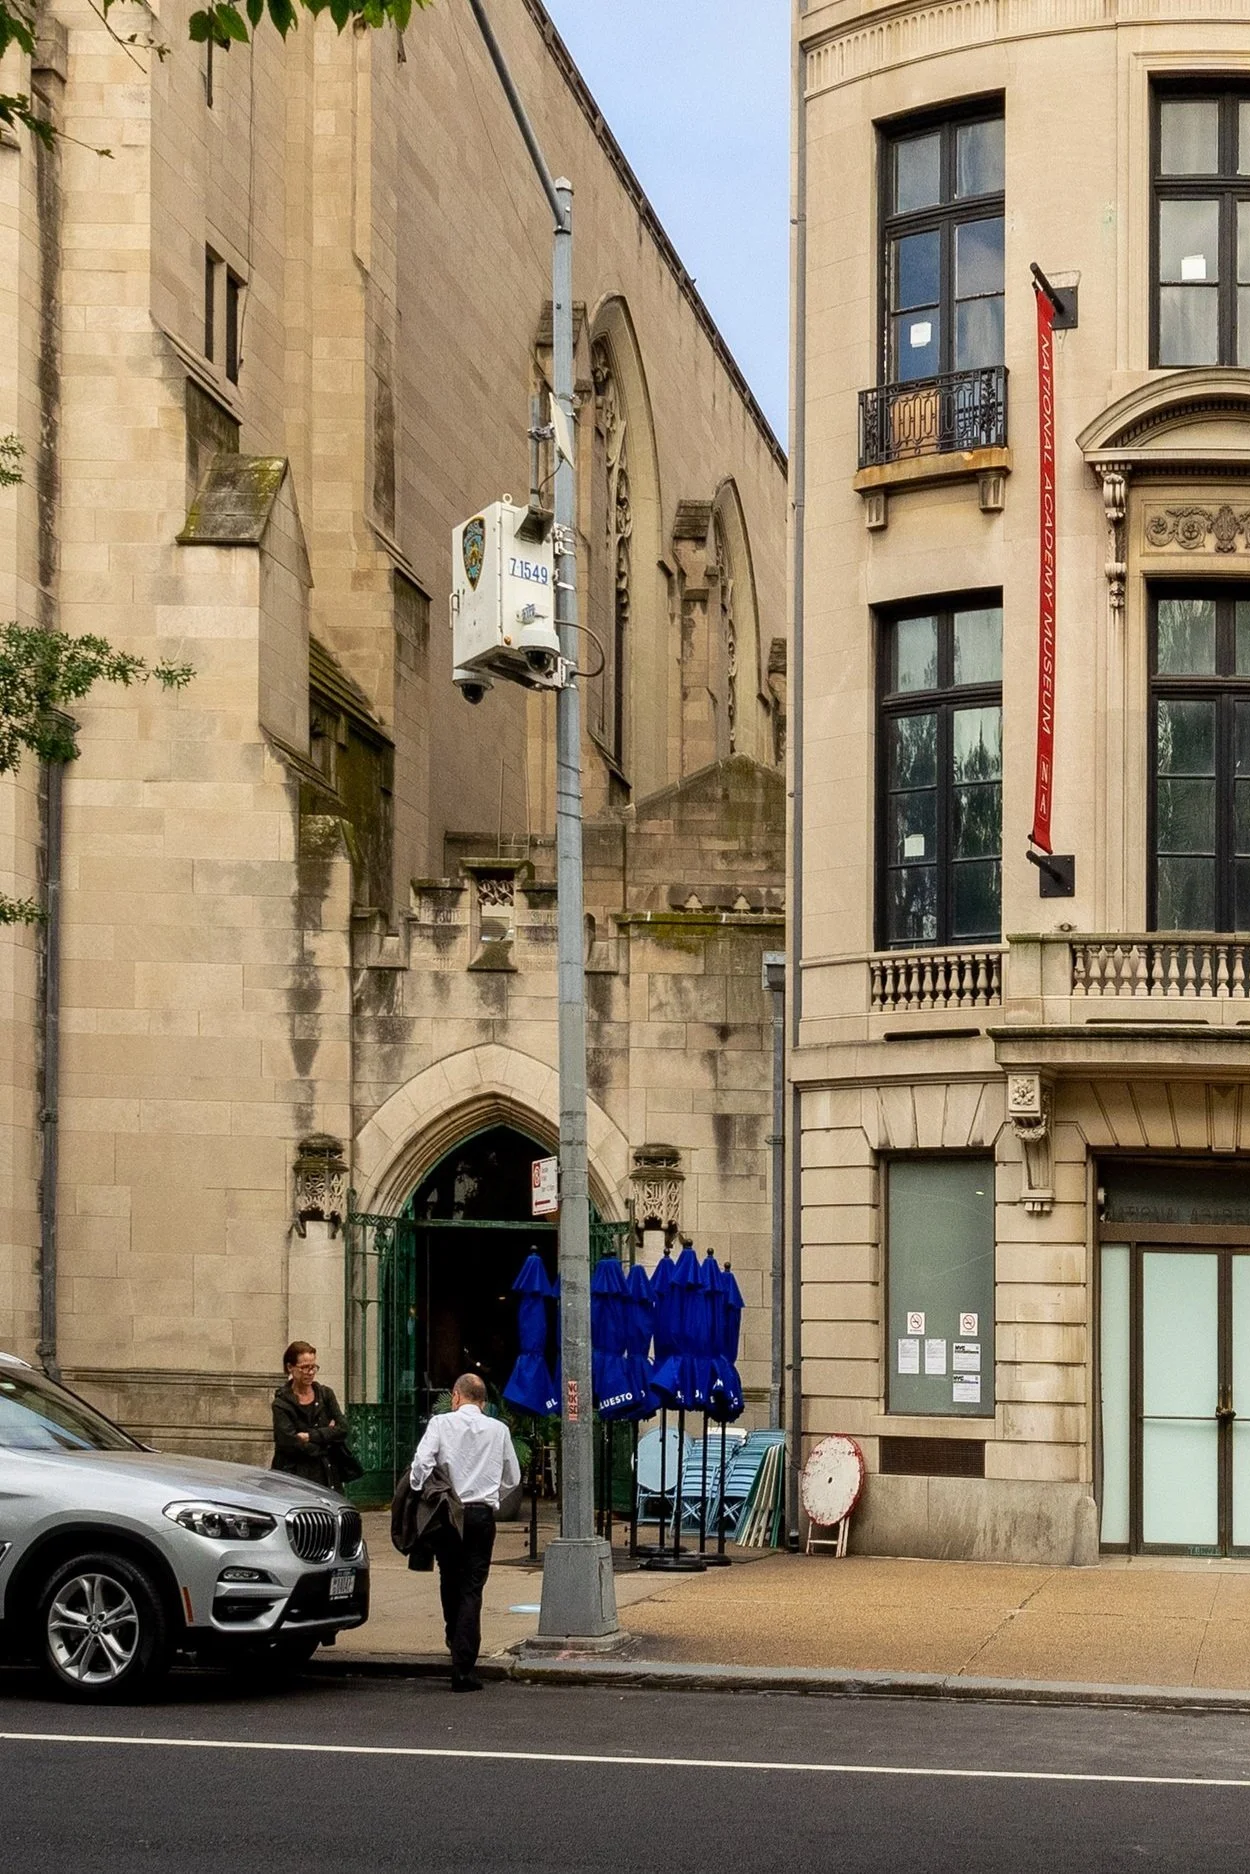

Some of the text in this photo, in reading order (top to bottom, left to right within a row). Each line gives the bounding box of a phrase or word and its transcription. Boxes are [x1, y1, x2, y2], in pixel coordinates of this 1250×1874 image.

[1041, 334, 1053, 734] NATIONAL ACADEMY MUSEUM
